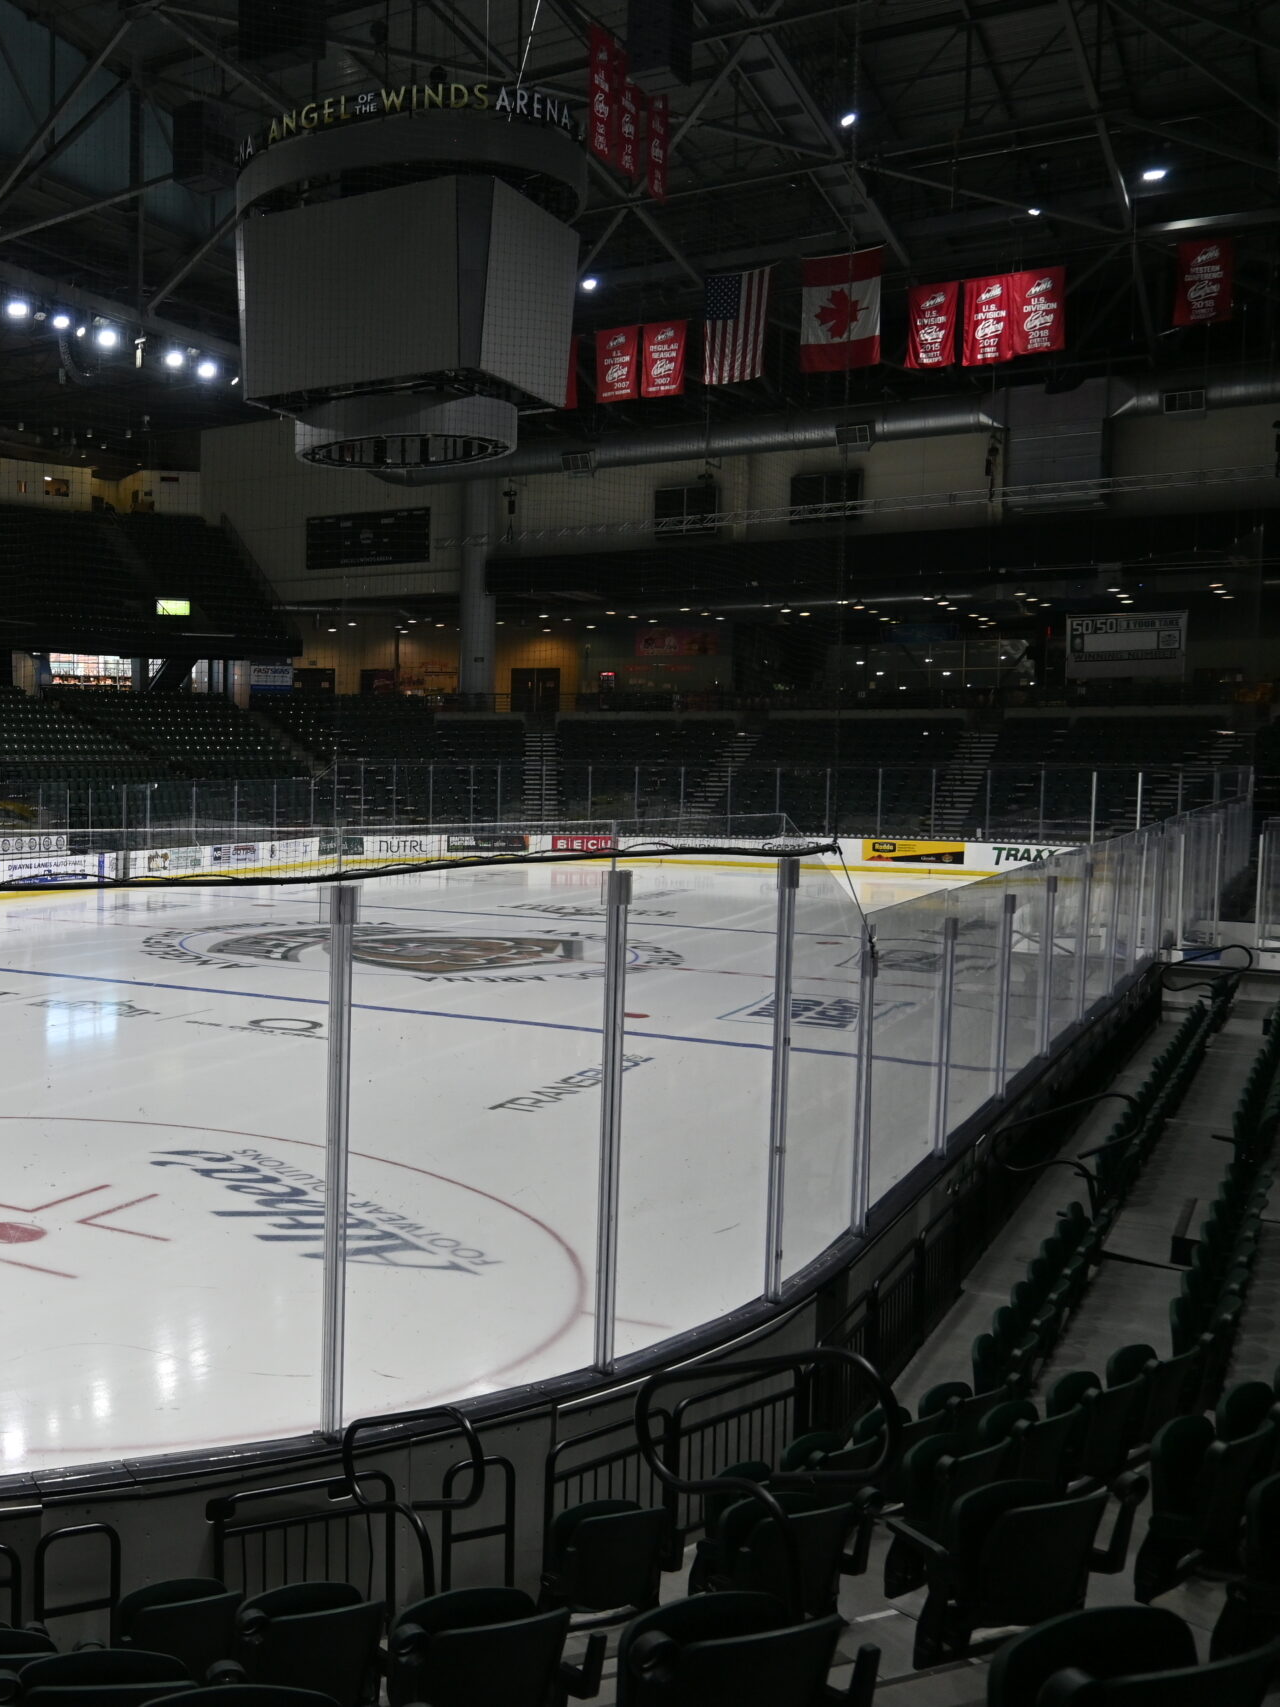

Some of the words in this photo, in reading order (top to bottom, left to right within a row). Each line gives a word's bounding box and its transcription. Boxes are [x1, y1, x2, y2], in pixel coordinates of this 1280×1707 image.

[357, 93, 375, 103] OF
[354, 104, 377, 115] THE
[380, 84, 488, 113] WINDS
[495, 86, 571, 130] ARENA
[269, 95, 352, 144] ANGEL
[1031, 297, 1047, 305] U.S.
[982, 304, 998, 312] U.S.
[1023, 302, 1057, 313] DIVISION
[925, 310, 938, 318] U.S.
[974, 310, 1006, 320] DIVISION
[917, 315, 947, 325] DIVISION
[1028, 330, 1049, 339] 2018
[650, 343, 678, 352] REGULAR
[921, 343, 940, 351] 2015
[979, 338, 999, 347] 2017
[604, 355, 631, 365] DIVISION
[652, 351, 676, 359] SEASON
[1072, 619, 1117, 635] 50/50
[556, 839, 612, 851] BECU
[230, 1148, 357, 1198] OLUTIONS
[366, 1200, 504, 1267] FOOTWEAR
